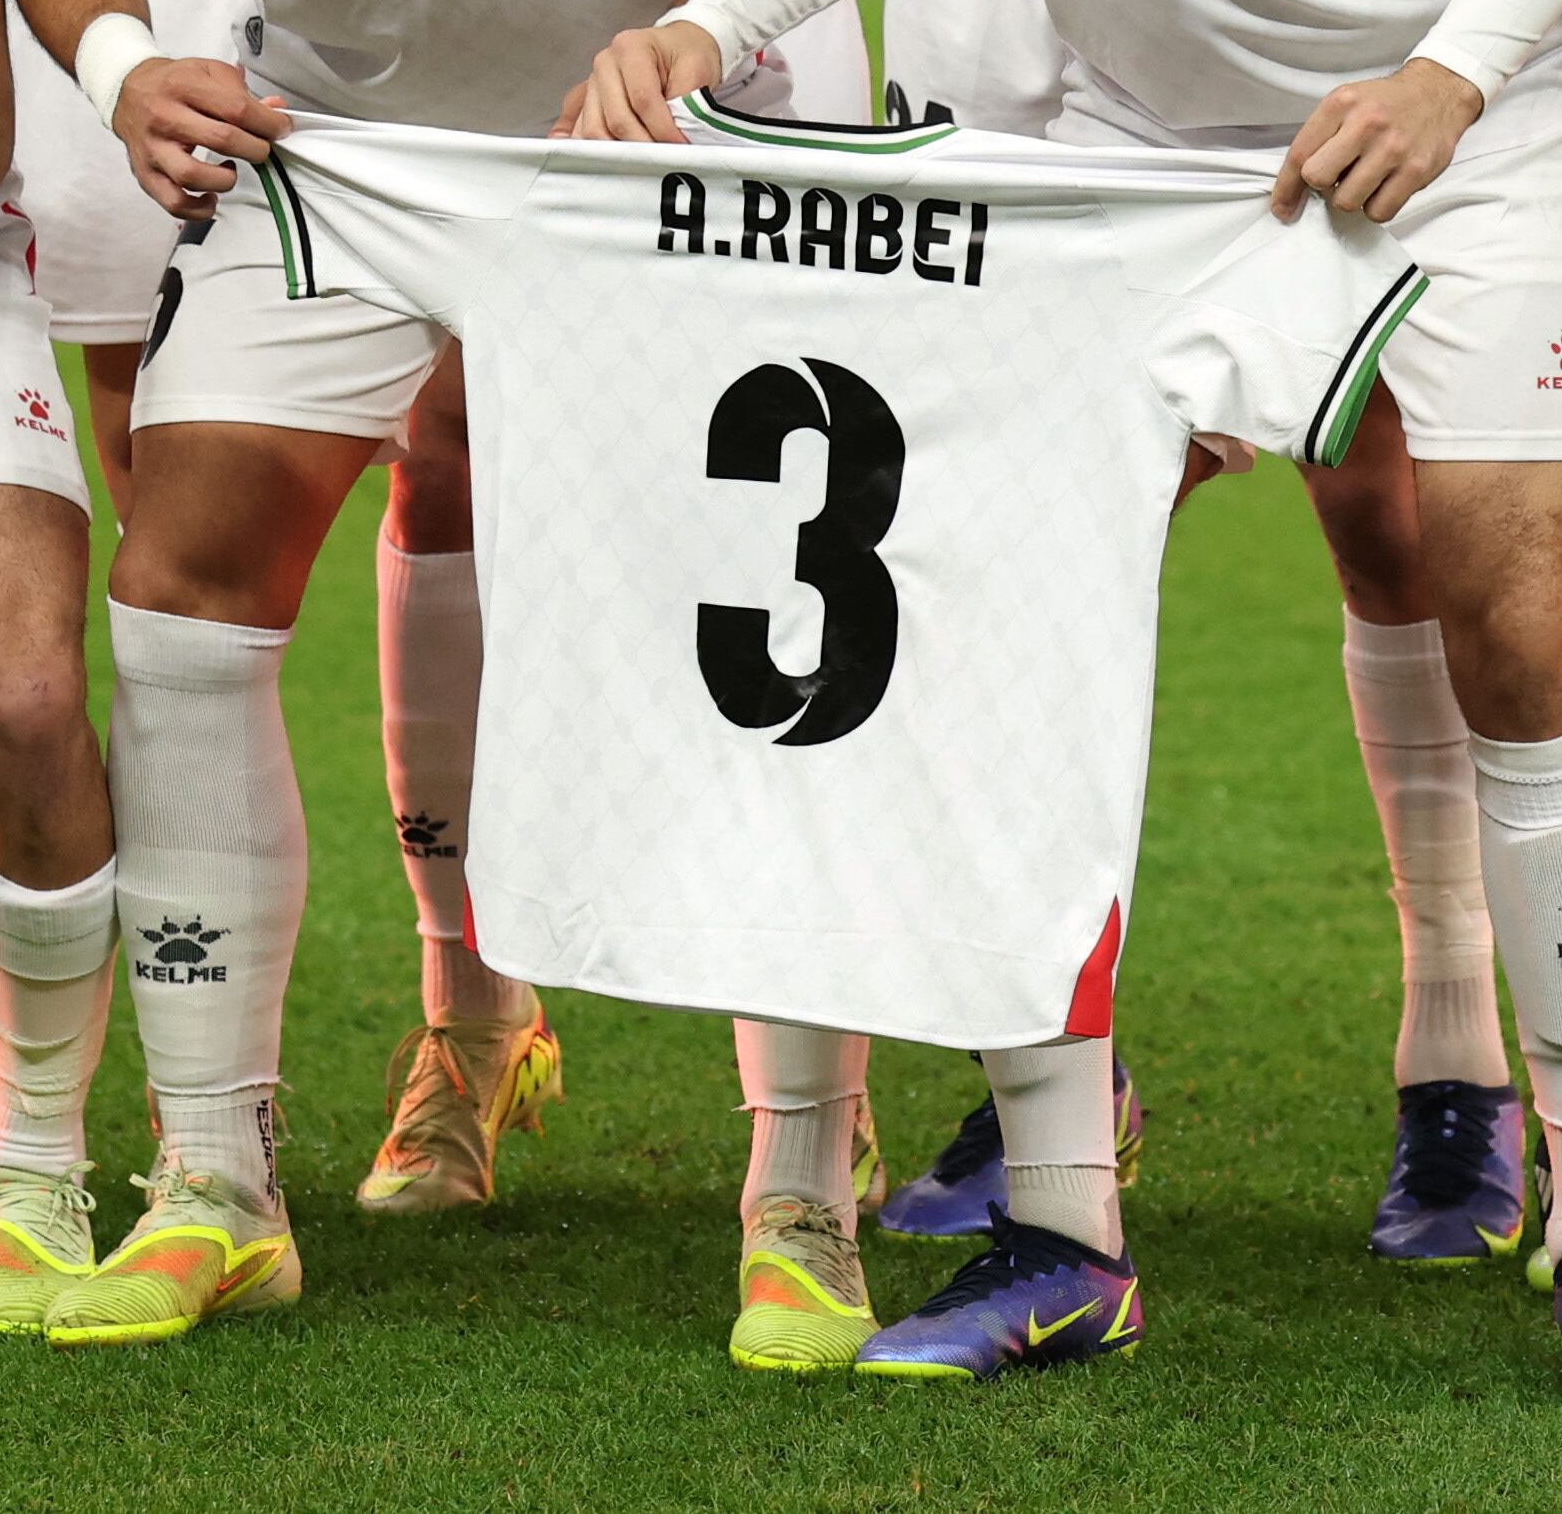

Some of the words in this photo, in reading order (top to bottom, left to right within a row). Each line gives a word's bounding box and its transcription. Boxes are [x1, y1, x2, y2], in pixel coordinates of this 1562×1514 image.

[656, 171, 989, 287] A.RABEI
[14, 416, 68, 442] KELME
[696, 357, 906, 747] 3
[135, 960, 227, 984] KELME
